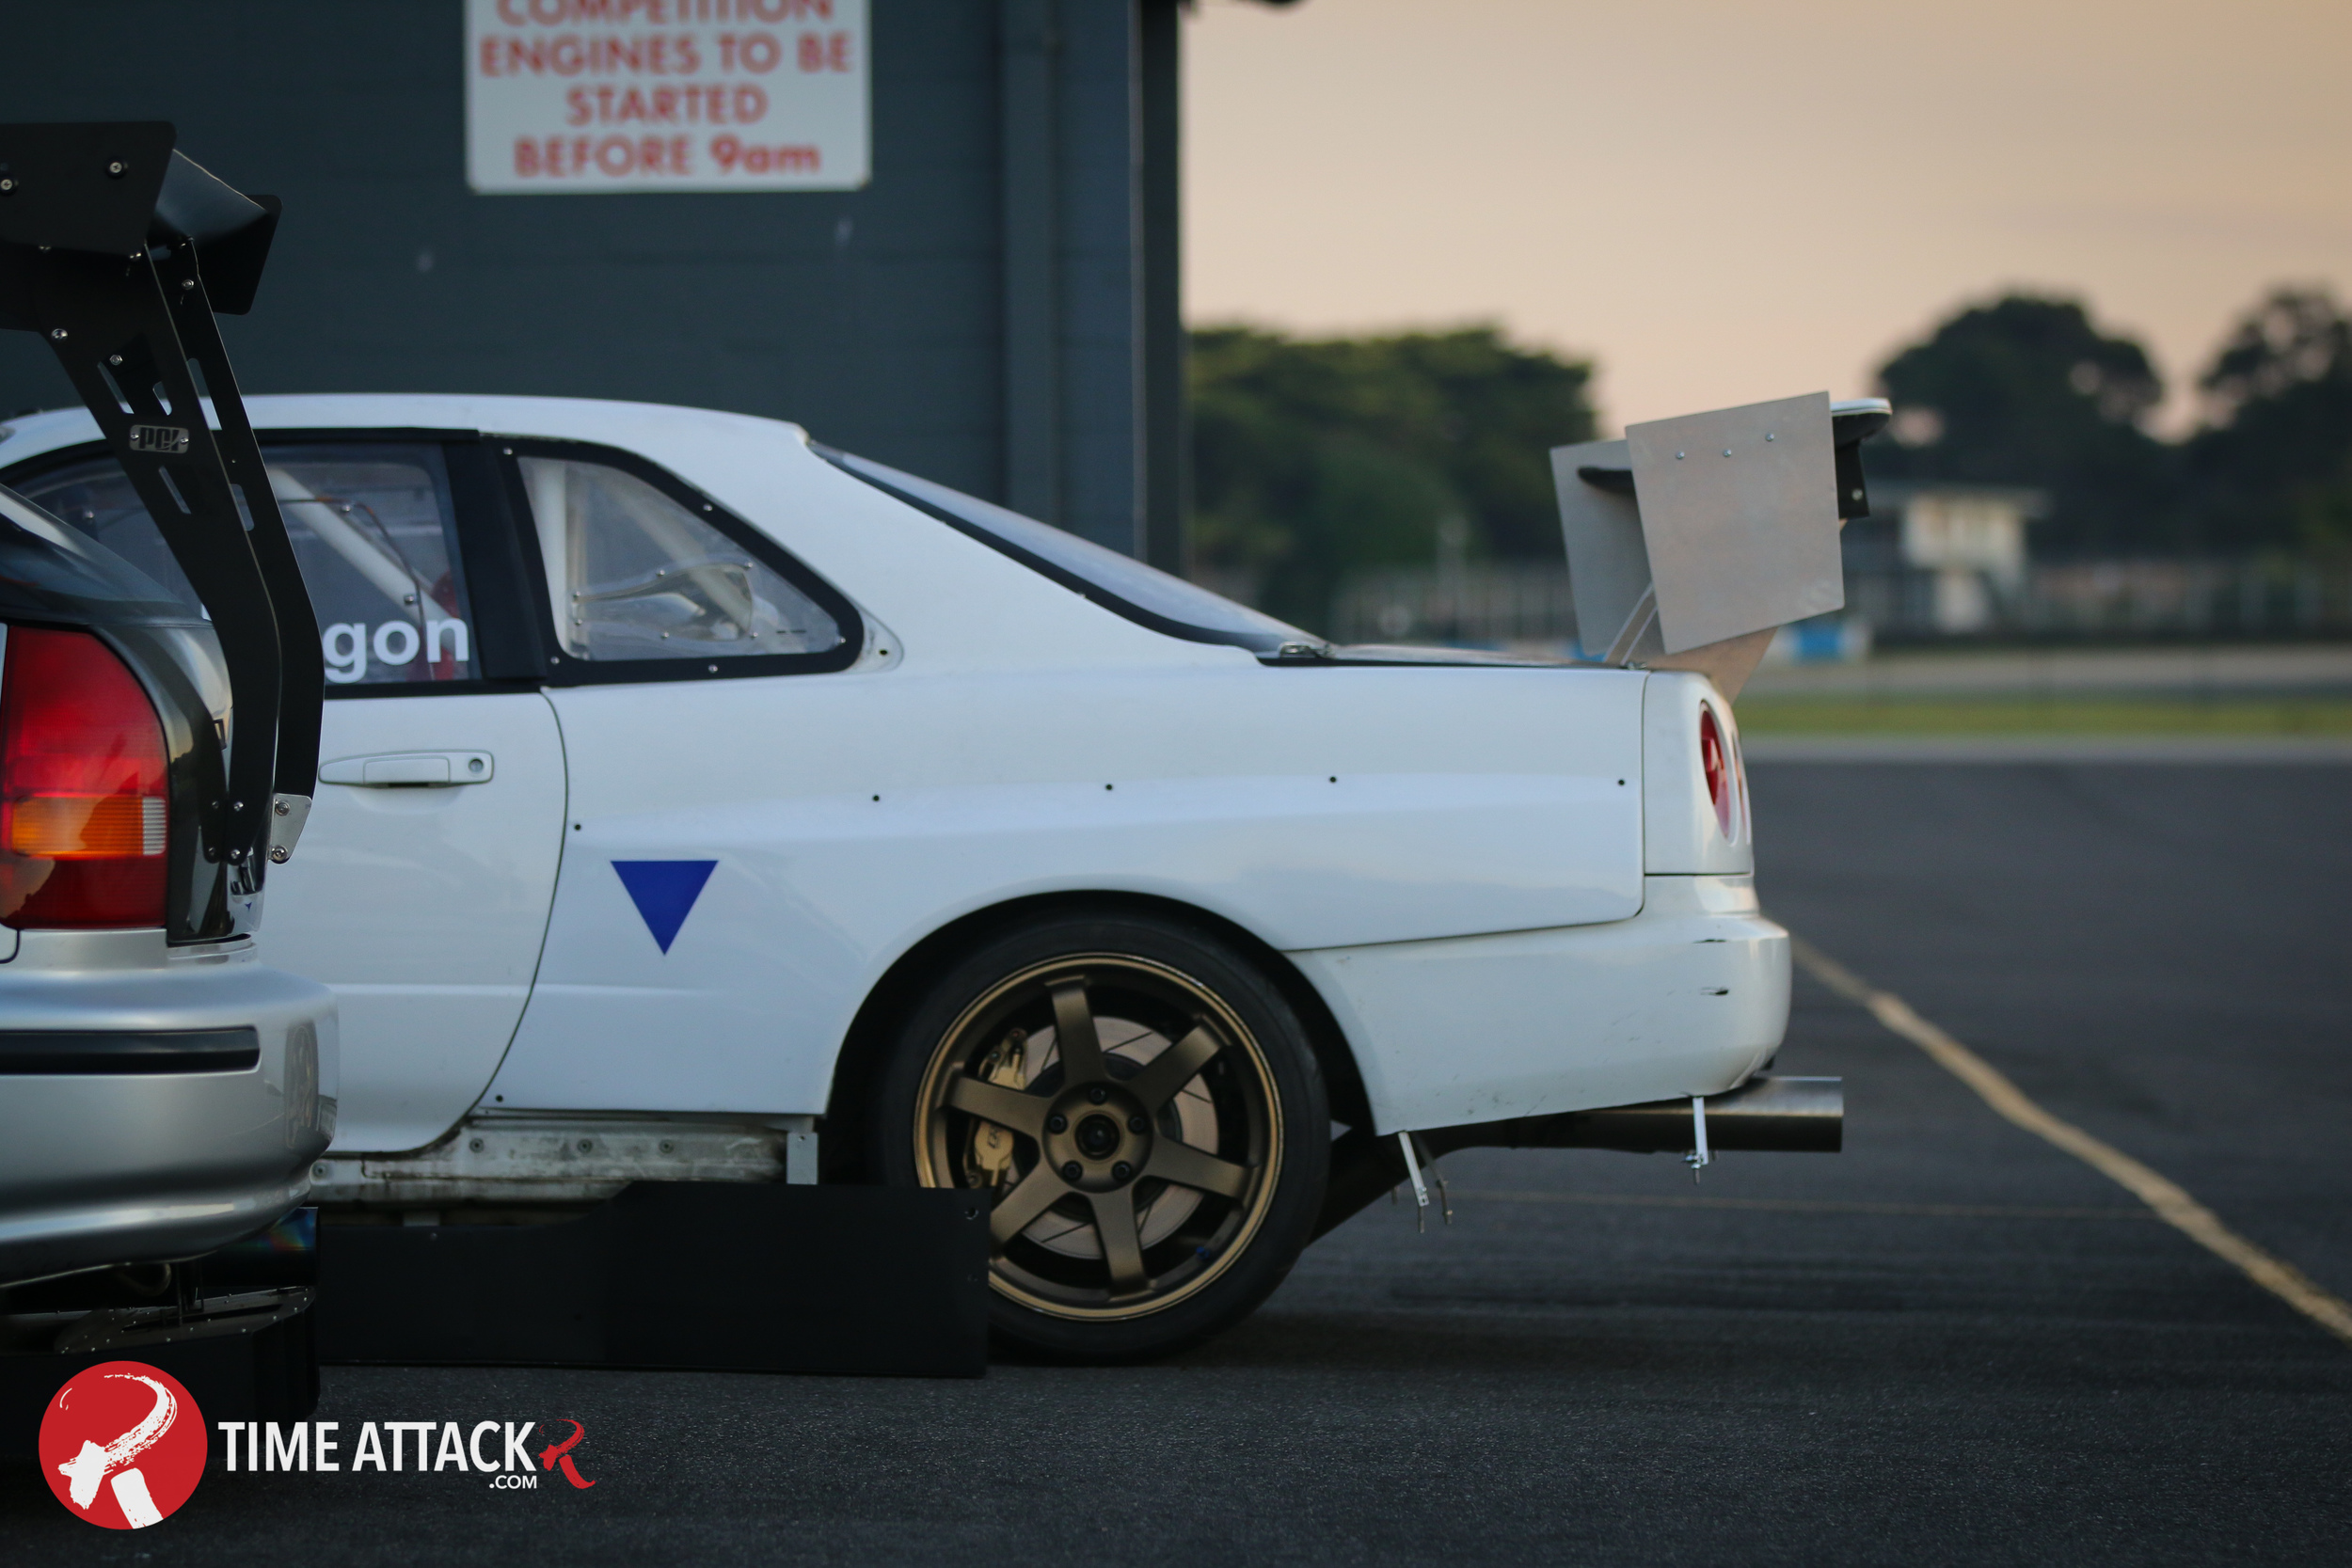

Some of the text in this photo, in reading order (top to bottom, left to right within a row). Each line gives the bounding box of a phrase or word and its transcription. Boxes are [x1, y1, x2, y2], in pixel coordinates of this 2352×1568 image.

[480, 32, 850, 77] ENGINES TO BE
[566, 83, 769, 126] STARTED
[514, 134, 821, 178] BEFORE 9am
